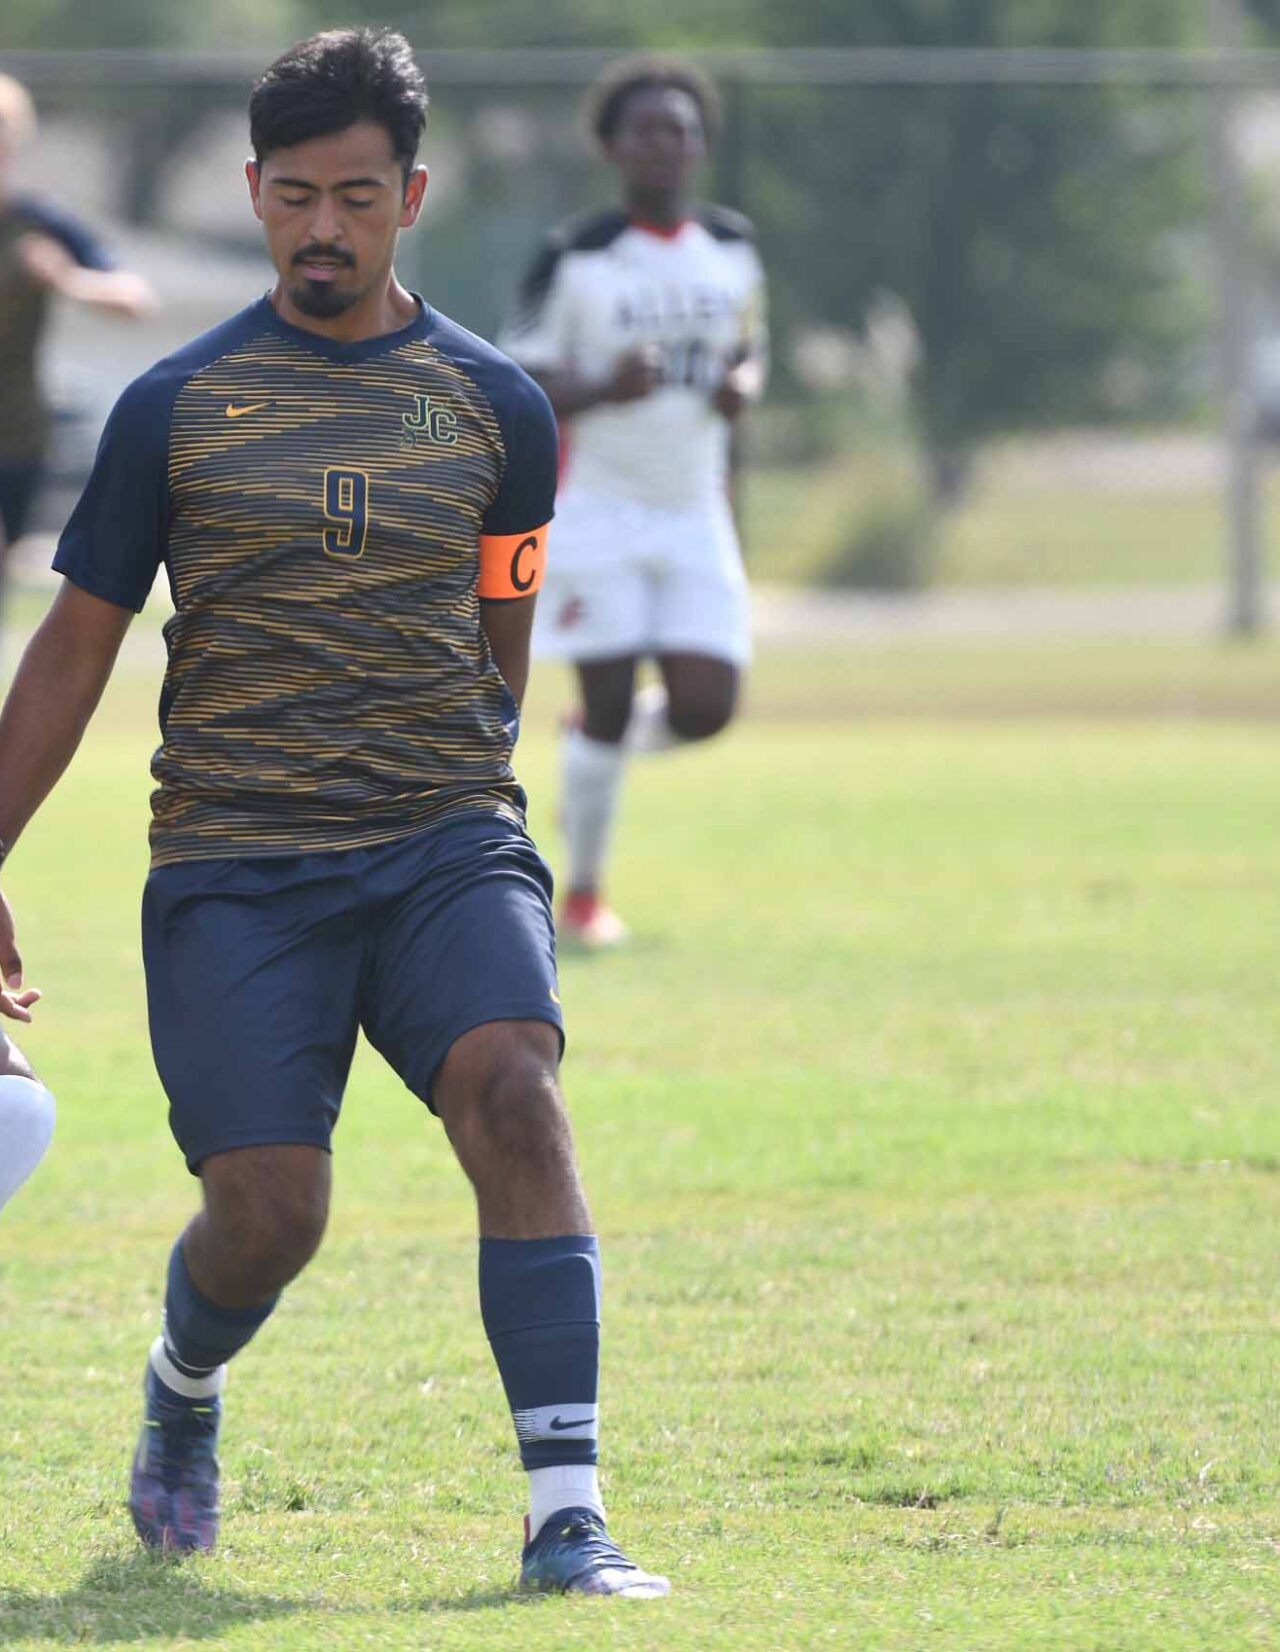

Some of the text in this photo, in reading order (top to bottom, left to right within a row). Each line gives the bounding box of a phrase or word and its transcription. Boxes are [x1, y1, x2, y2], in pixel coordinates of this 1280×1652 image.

[402, 394, 458, 446] JC
[323, 465, 370, 560] 9
[510, 535, 538, 593] C
